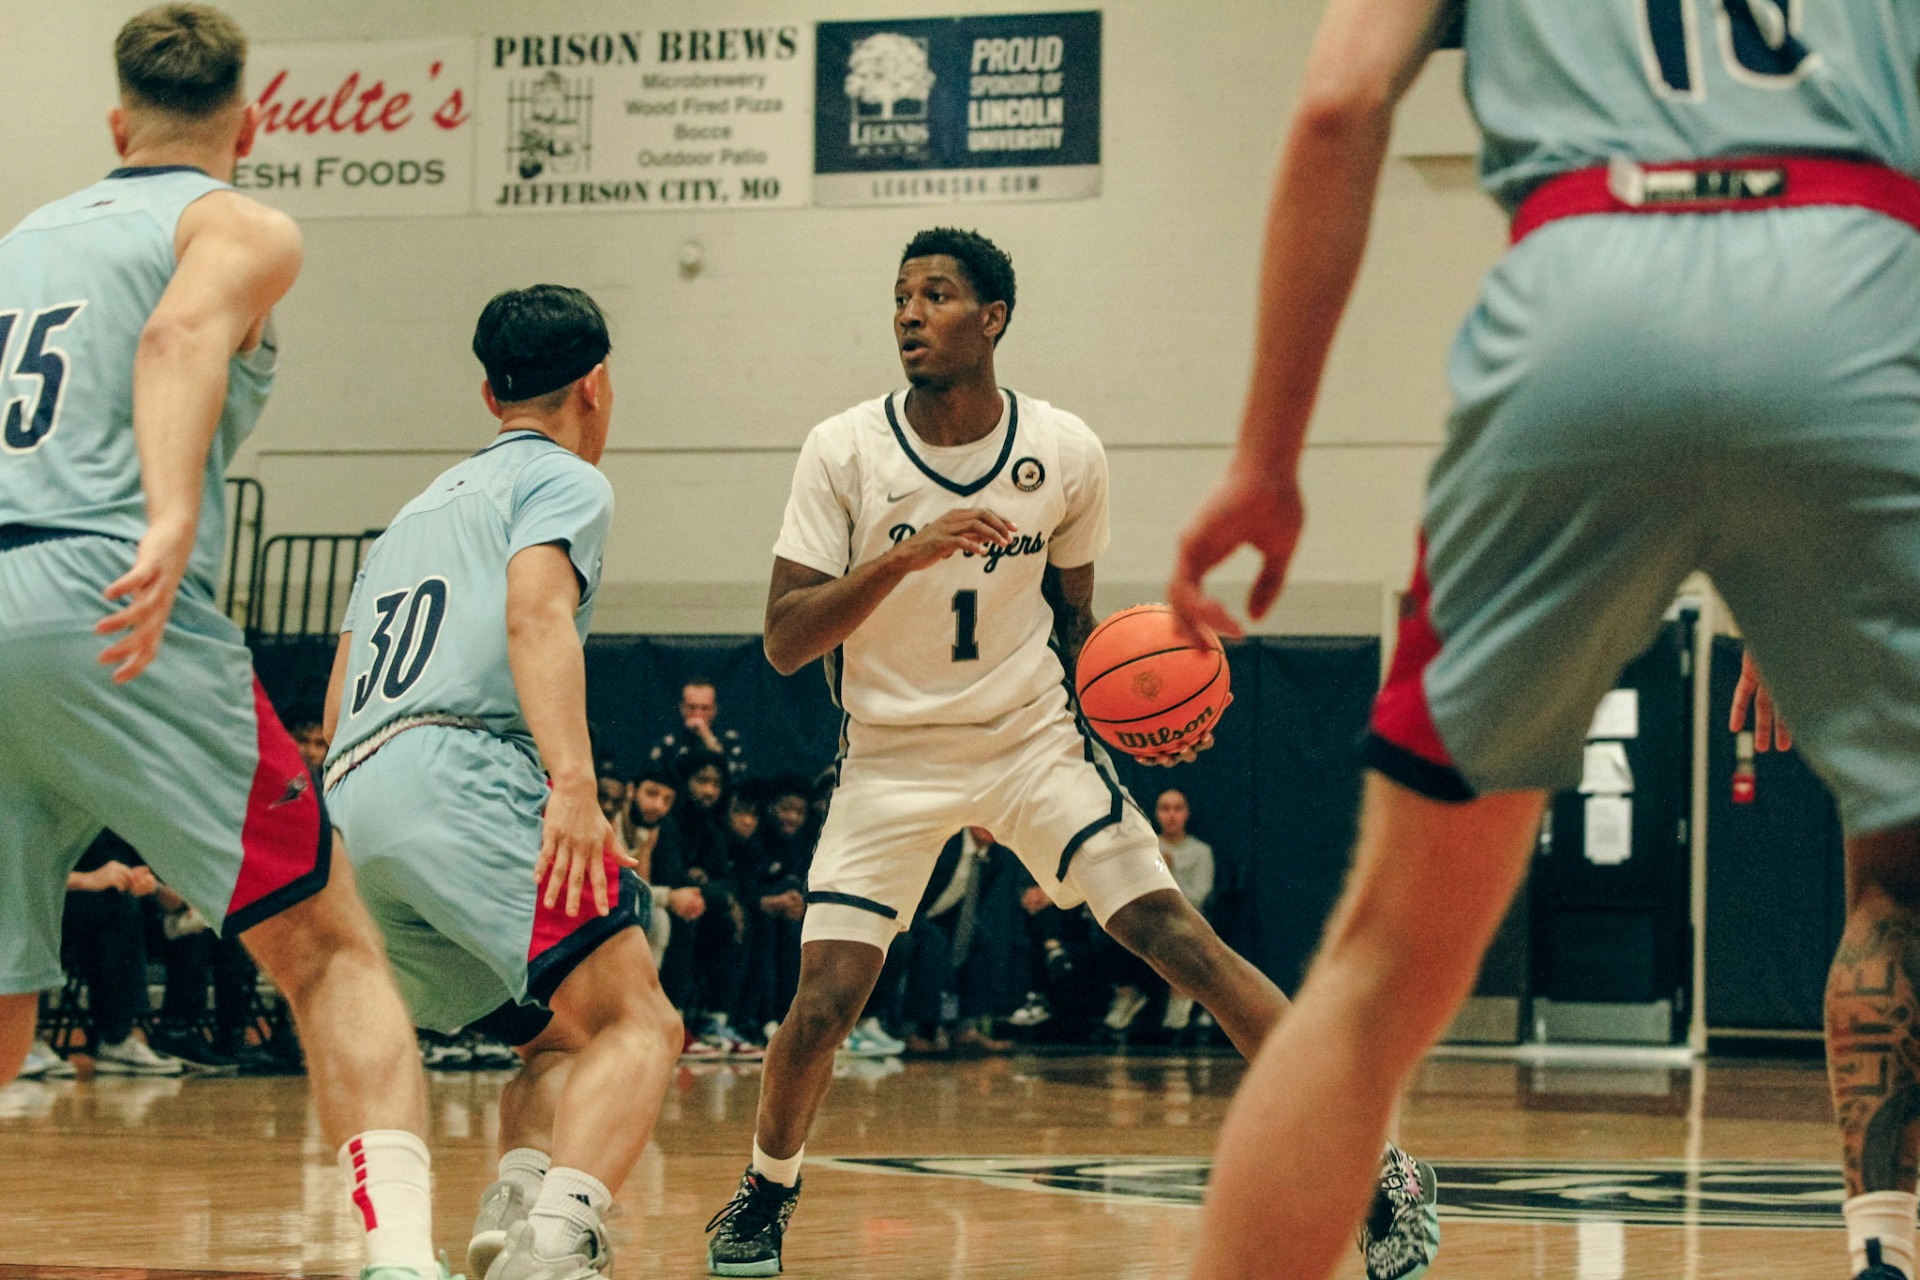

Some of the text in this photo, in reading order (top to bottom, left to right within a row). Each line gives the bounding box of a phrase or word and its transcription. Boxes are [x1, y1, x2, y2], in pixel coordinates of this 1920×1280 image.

[495, 26, 798, 68] PRISON BREWS
[971, 36, 1063, 73] PROUD
[250, 60, 470, 134] hulte's
[642, 73, 766, 91] Microbrewery
[735, 96, 783, 113] Pizza
[967, 97, 1063, 129] LINCOLN
[673, 124, 732, 141] Bocce
[232, 163, 301, 189] ESH
[496, 180, 650, 206] JEFFERSON
[740, 176, 781, 200] MO
[951, 588, 980, 663] 1
[350, 575, 451, 719] 30
[1114, 706, 1214, 749] Wilson
